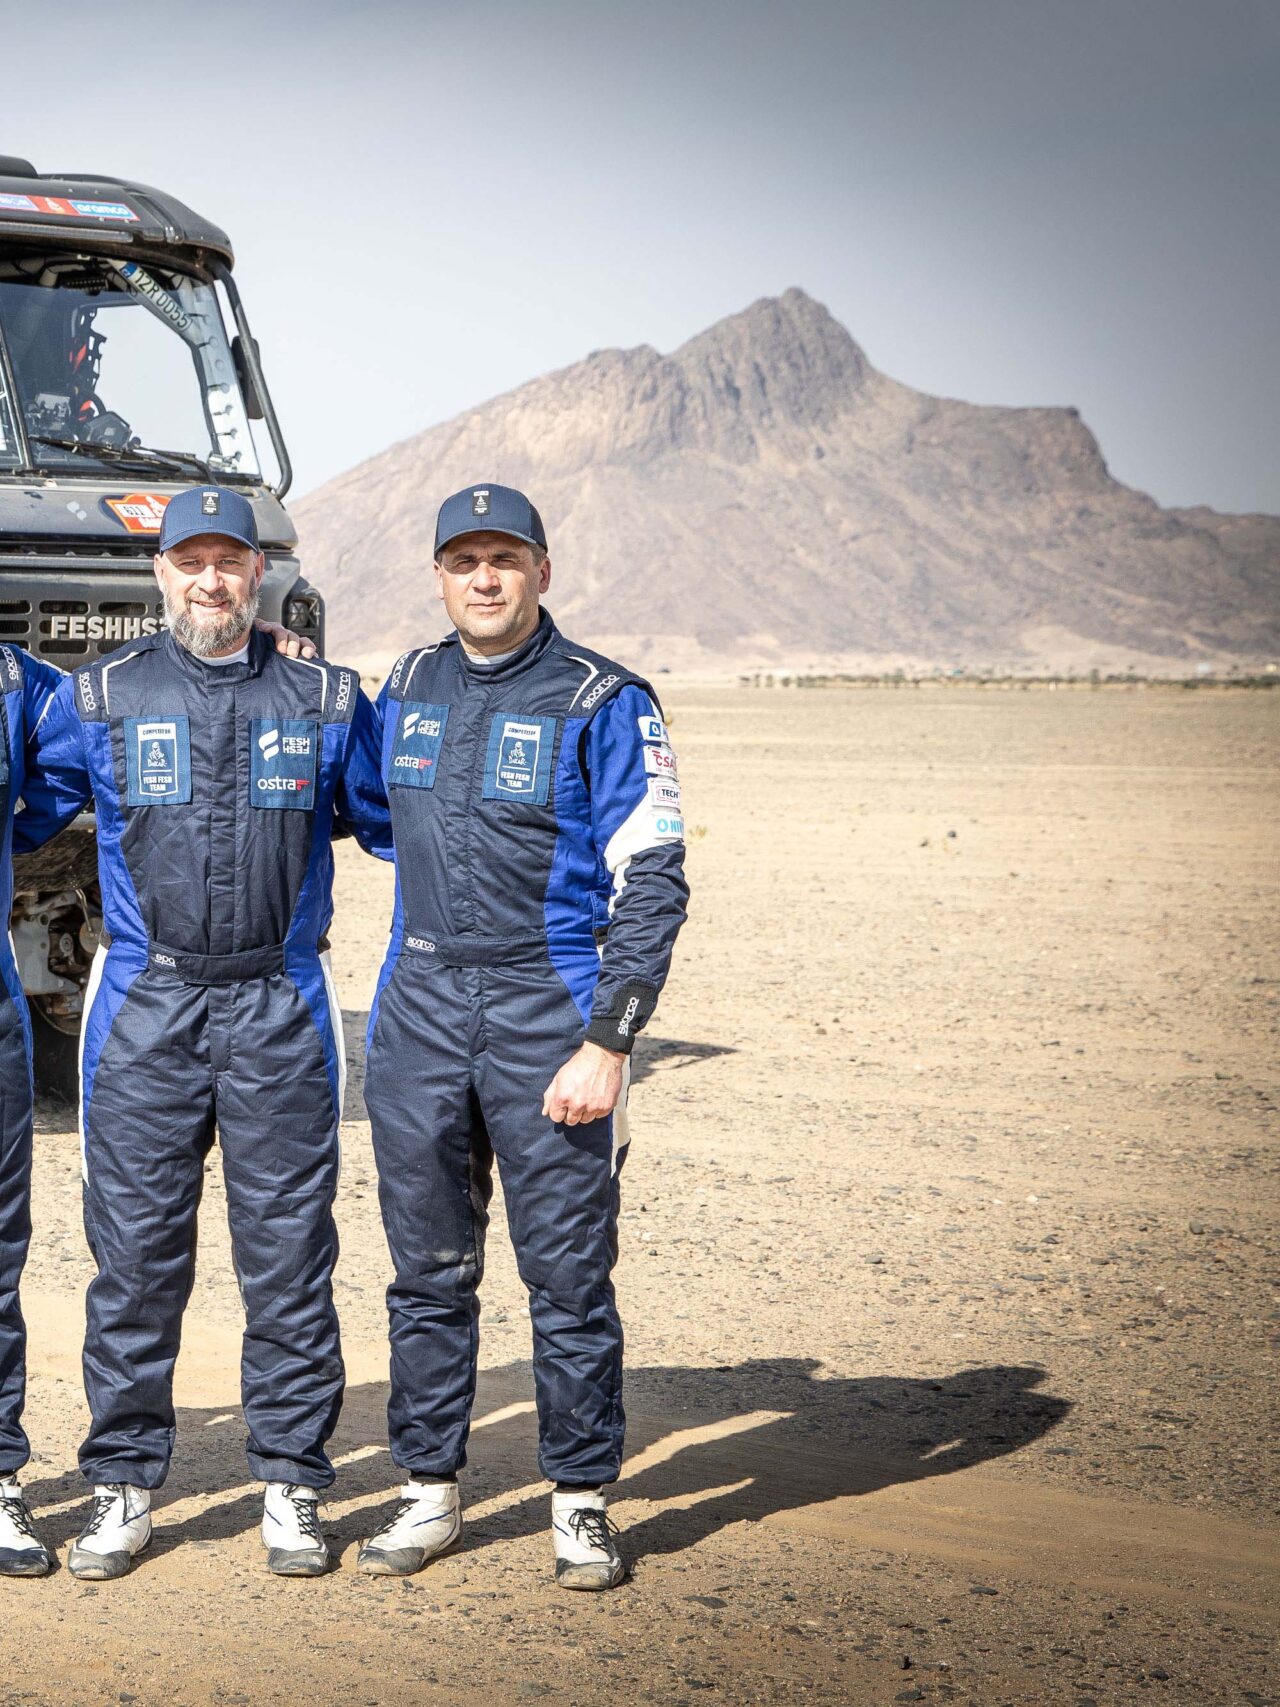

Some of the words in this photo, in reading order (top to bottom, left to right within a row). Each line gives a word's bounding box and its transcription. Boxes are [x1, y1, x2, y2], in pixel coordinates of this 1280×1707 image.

[76, 203, 129, 216] aramco
[123, 506, 146, 516] 611
[50, 616, 170, 640] FESHHS
[79, 672, 96, 711] sparco
[582, 674, 618, 709] sparco
[282, 737, 310, 746] FESH
[507, 779, 523, 788] TEAM
[662, 789, 679, 799] TECH
[407, 936, 435, 950] sparco
[617, 996, 639, 1036] sparco
